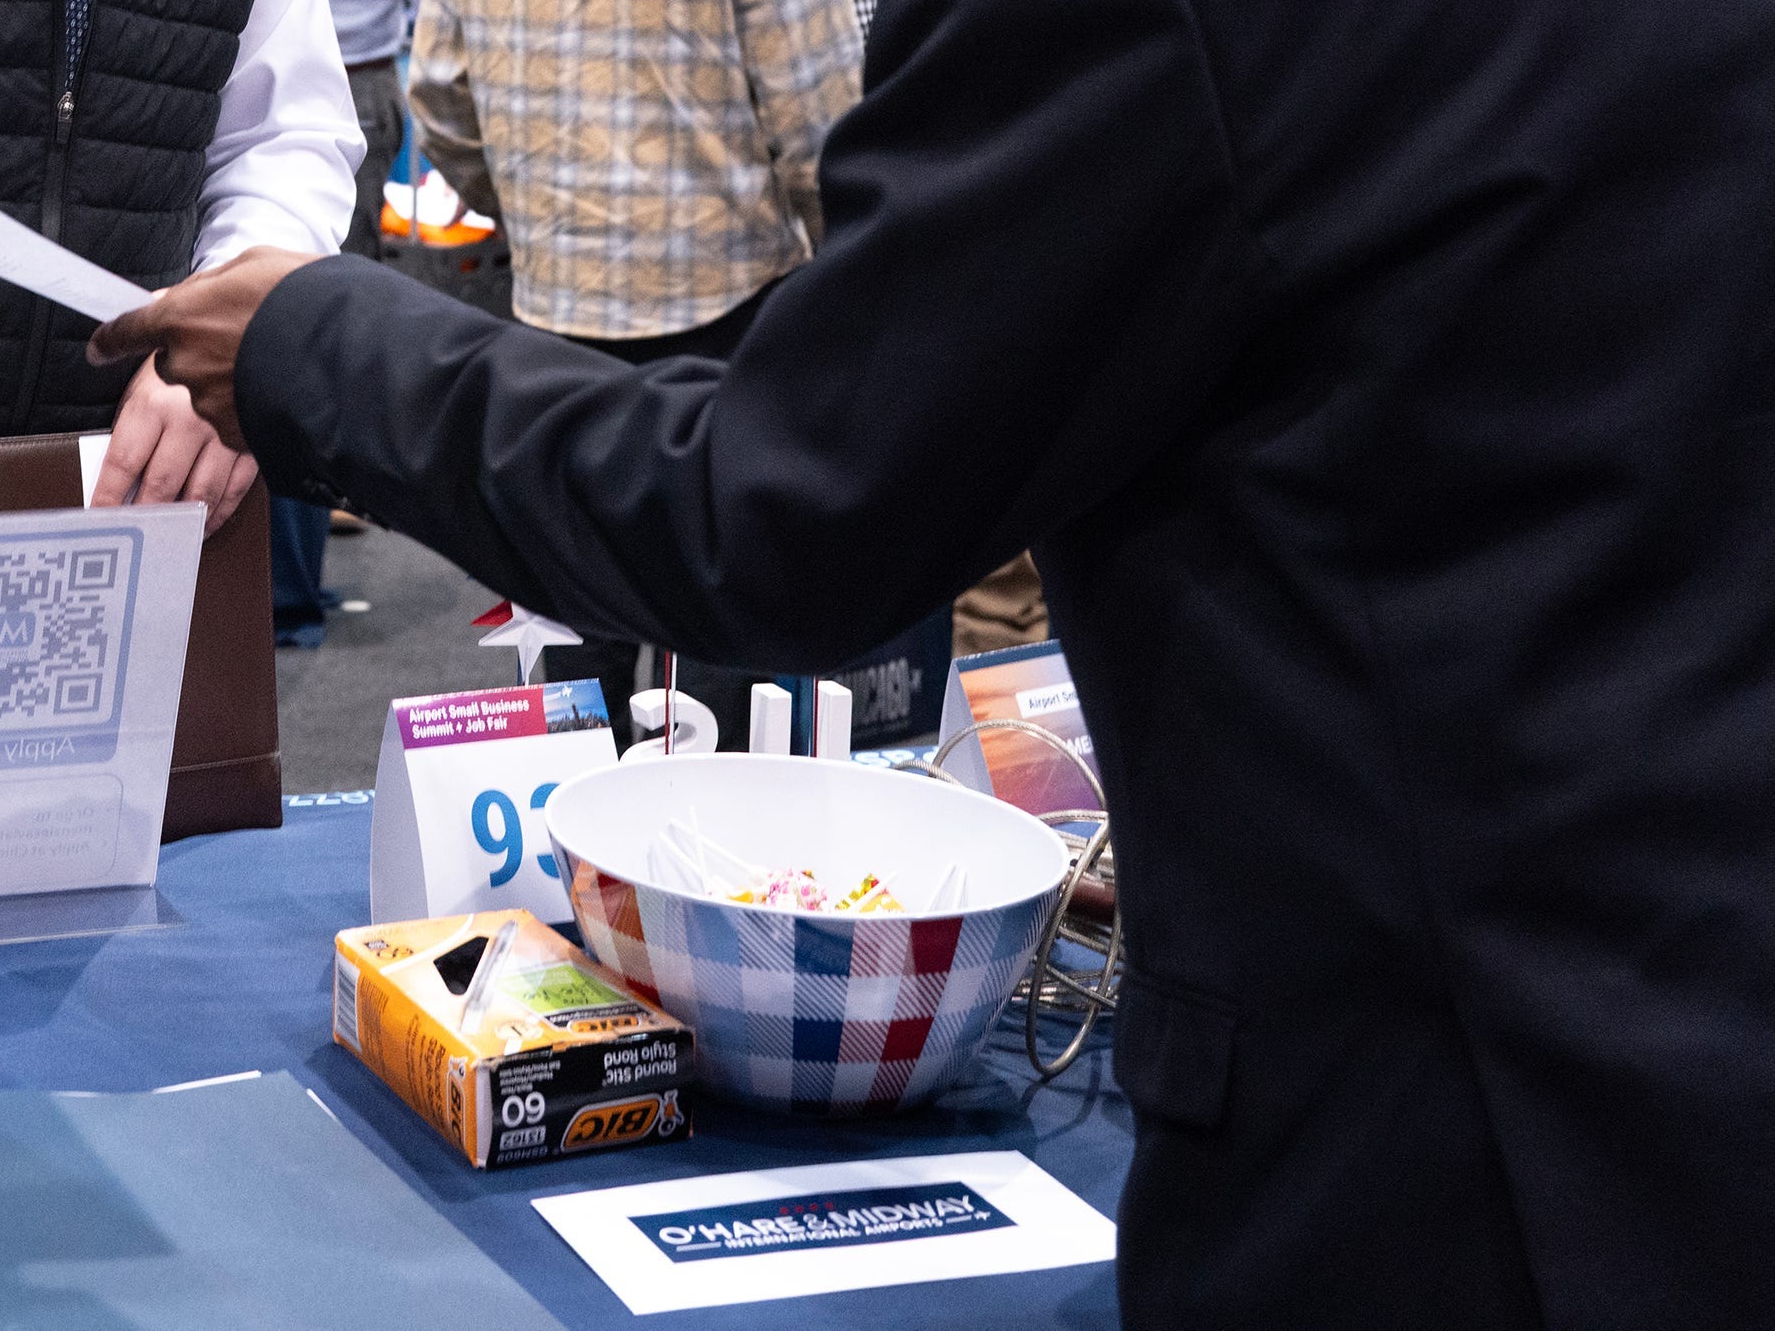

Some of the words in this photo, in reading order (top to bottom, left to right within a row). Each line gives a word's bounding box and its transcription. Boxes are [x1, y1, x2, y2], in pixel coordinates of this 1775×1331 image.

[409, 704, 448, 724] Airport
[448, 703, 480, 719] Small
[481, 698, 530, 715] Business
[1029, 693, 1059, 709] Airport
[412, 723, 454, 739] Summit
[465, 718, 485, 734] Job
[486, 715, 508, 731] Fair
[604, 1049, 639, 1068] Rond
[641, 1042, 677, 1064] Stylo
[634, 1058, 677, 1082] Round
[450, 1082, 462, 1148] BIC
[502, 1091, 546, 1128] 60
[572, 1107, 653, 1143] BIC
[659, 1214, 797, 1245] O'HARE
[831, 1195, 977, 1229] MIDWAY
[724, 1228, 861, 1249] INTERNATIONAL
[865, 1217, 943, 1236] AIRPORTS
